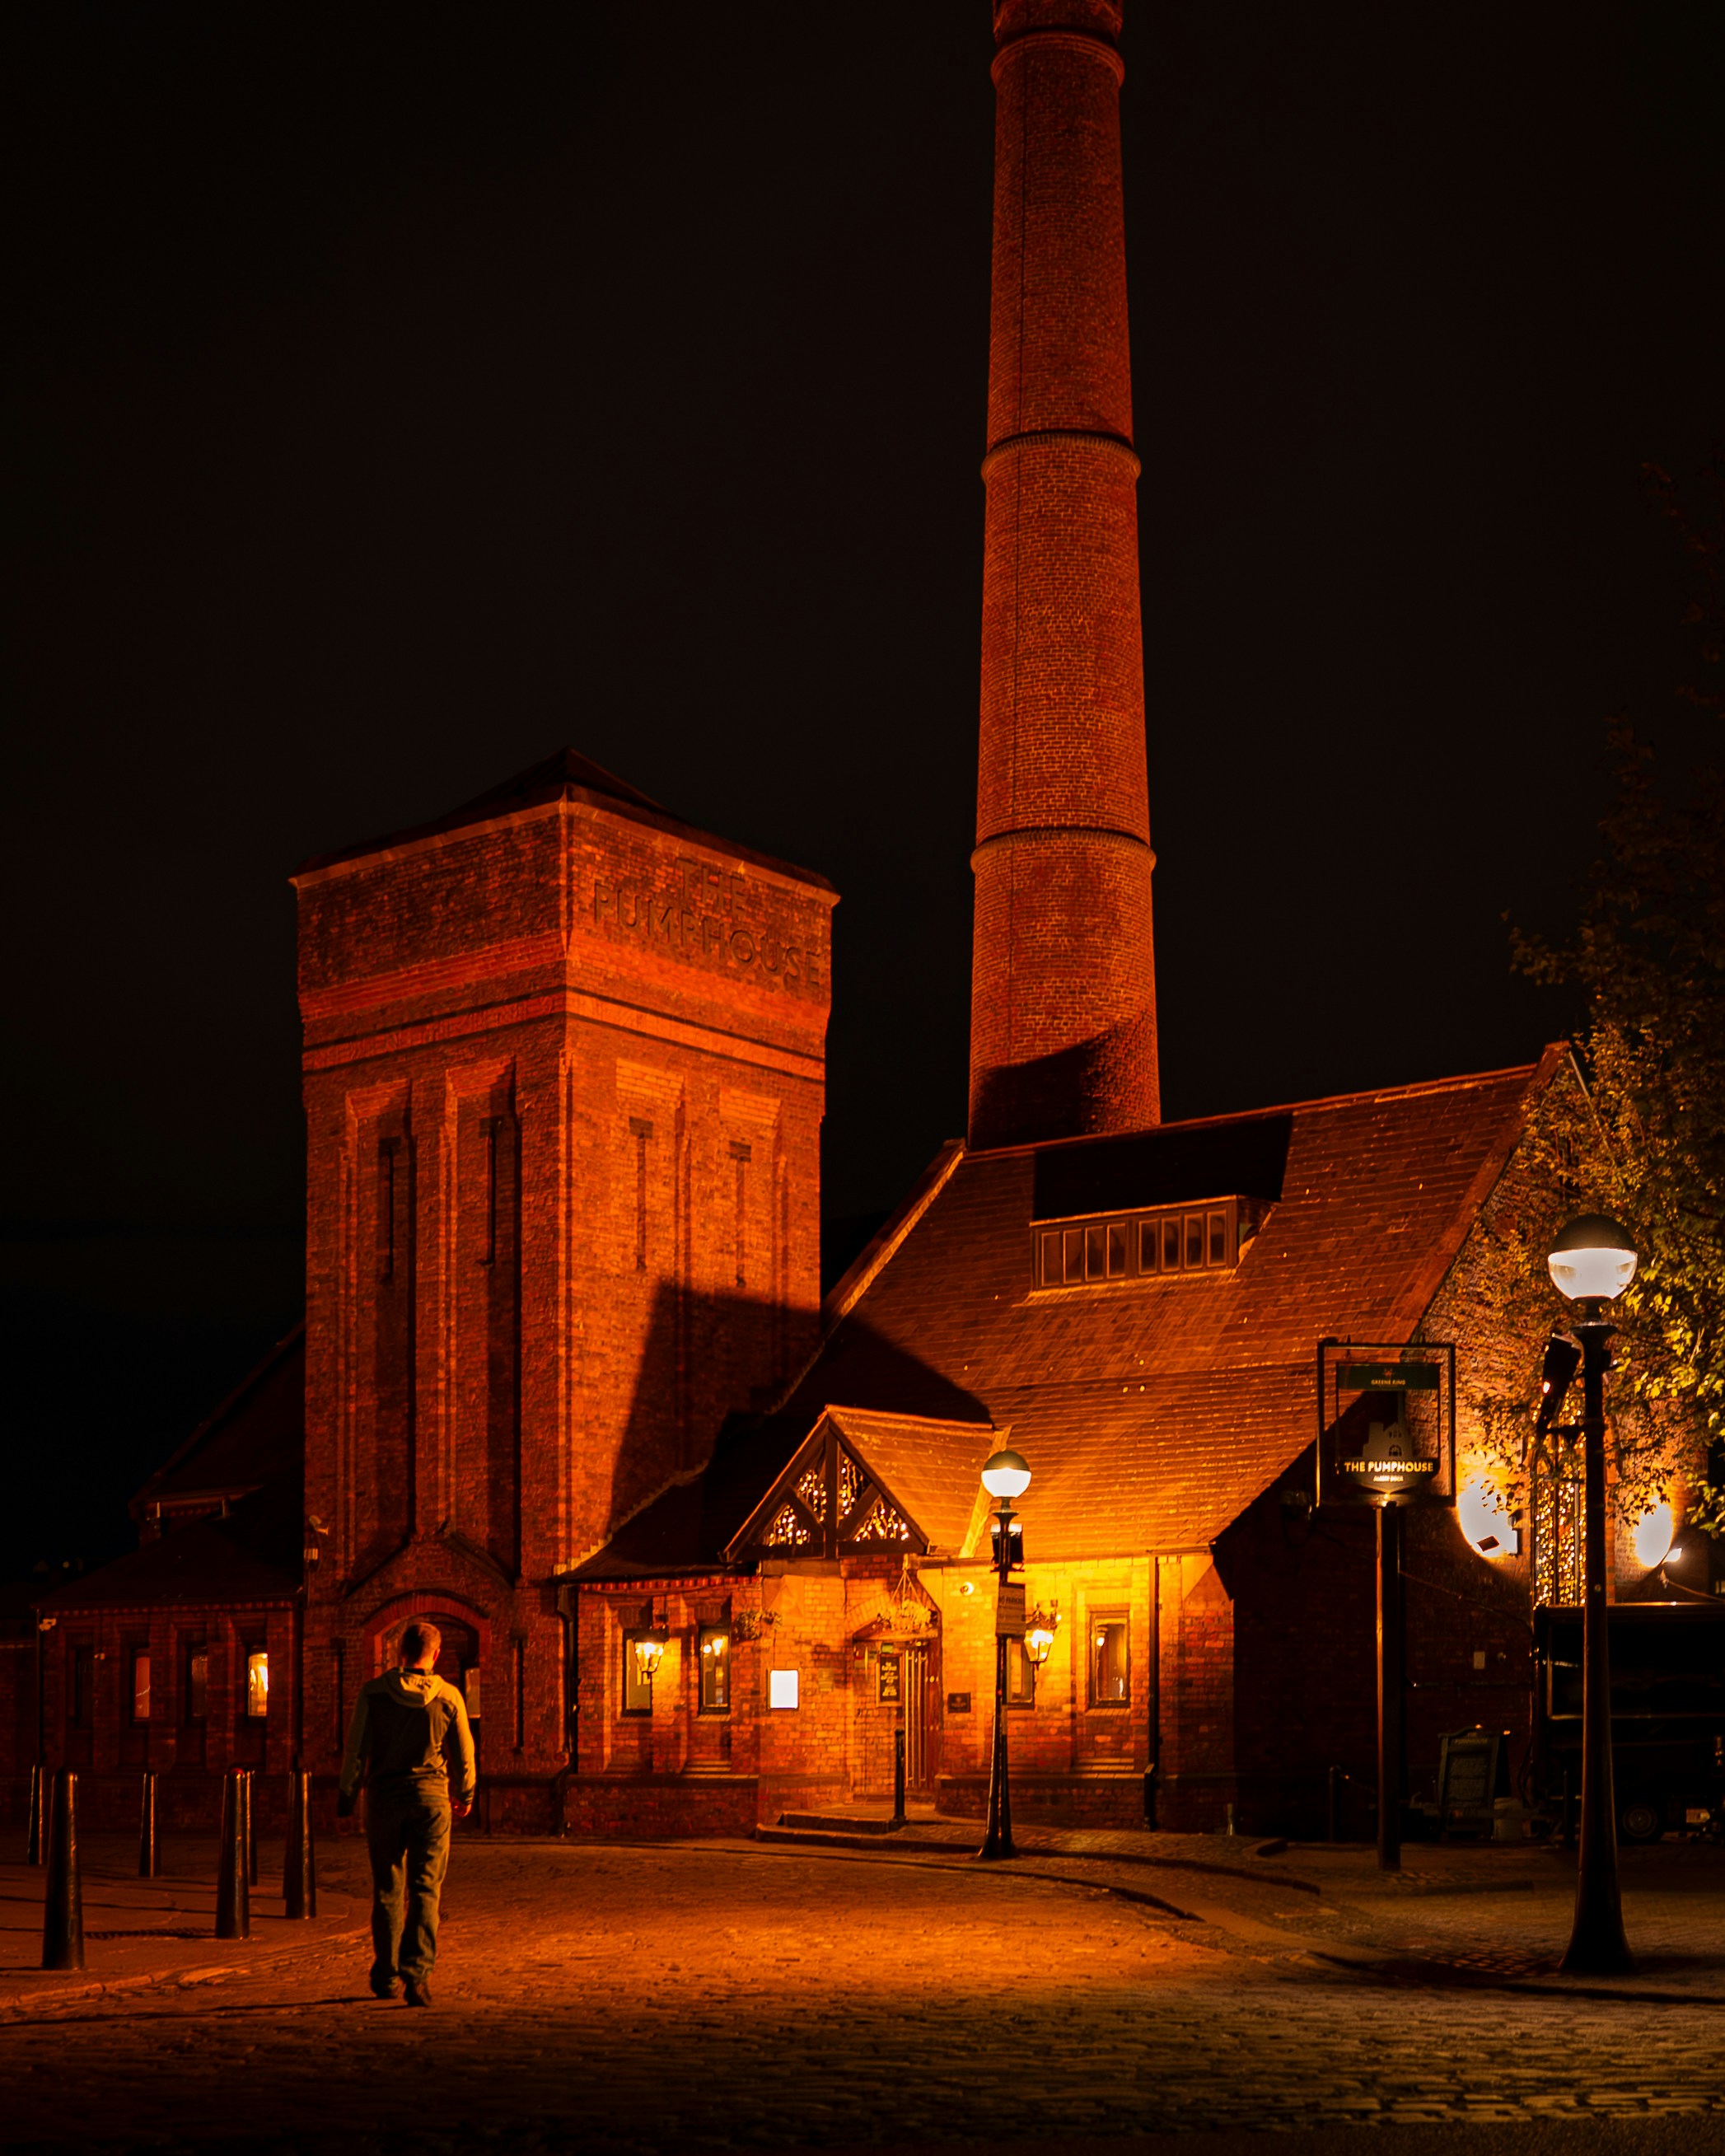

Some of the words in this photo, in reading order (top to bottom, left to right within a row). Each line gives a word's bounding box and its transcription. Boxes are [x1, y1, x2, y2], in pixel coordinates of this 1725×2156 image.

[676, 858, 746, 918] THE
[593, 882, 820, 987] PUMPHOUSE
[1344, 1461, 1366, 1471] THE
[1367, 1461, 1433, 1472] PUMPHOUSE
